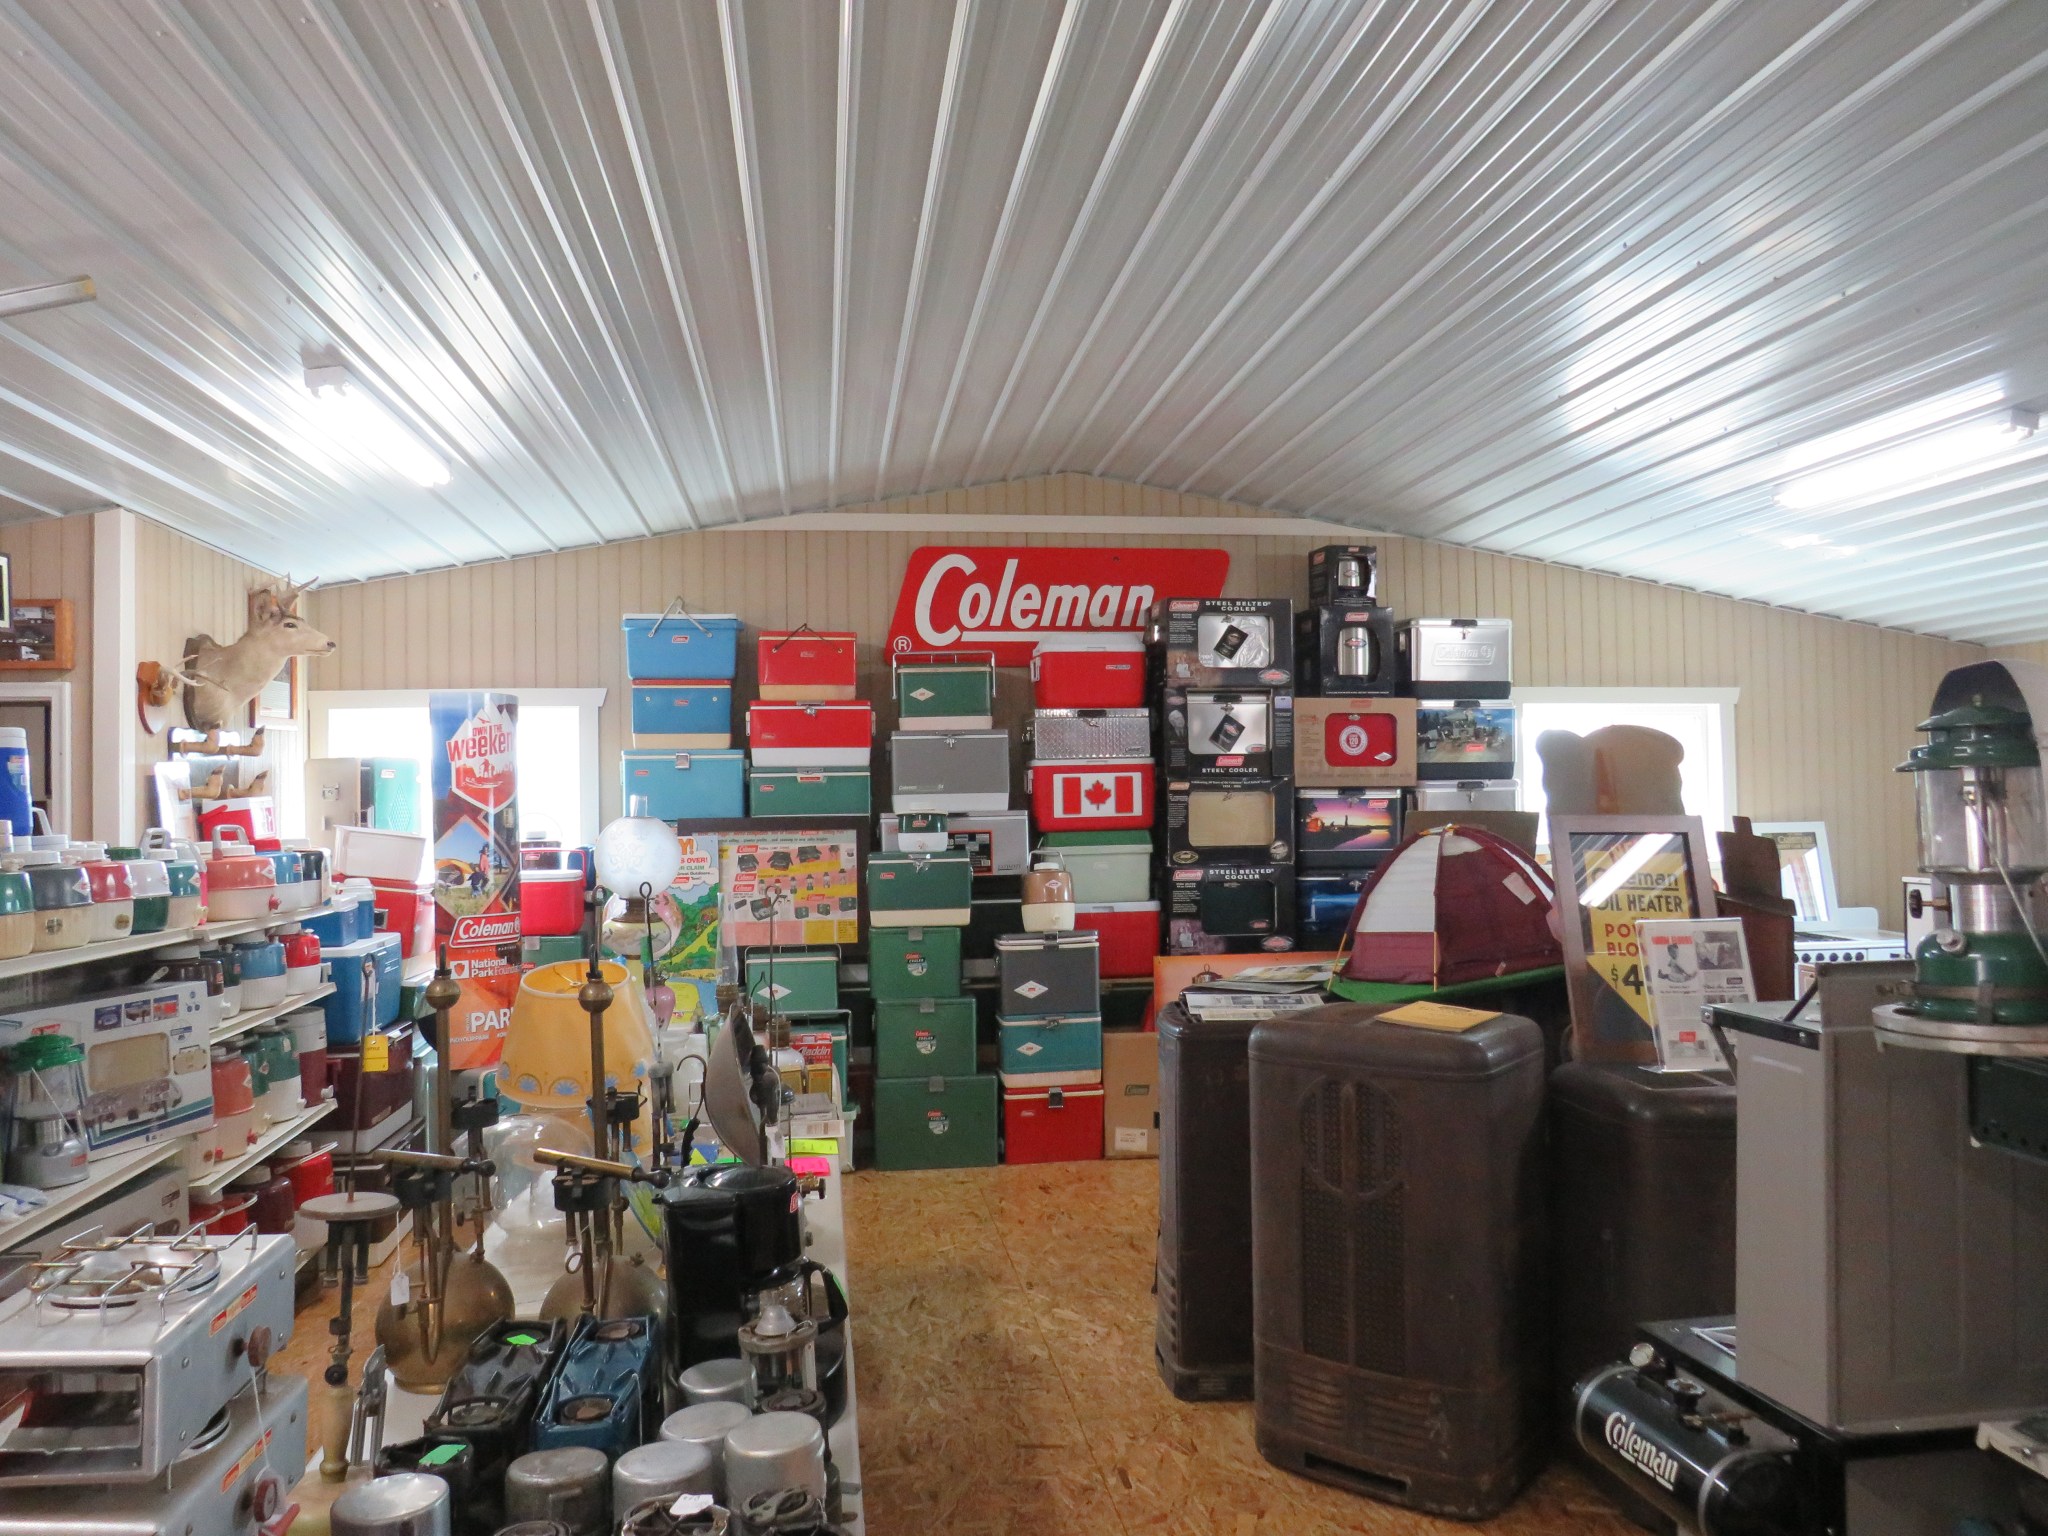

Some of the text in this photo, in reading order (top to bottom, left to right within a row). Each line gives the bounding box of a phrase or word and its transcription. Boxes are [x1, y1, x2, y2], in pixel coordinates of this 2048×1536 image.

[915, 553, 1154, 646] Coleman
[472, 724, 503, 737] OWN THE
[447, 725, 513, 763] weeken
[1175, 871, 1201, 879] Coleman
[1627, 894, 1683, 912] HEATER
[459, 919, 513, 940] Coleman
[471, 956, 507, 969] National
[471, 968, 494, 978] Park
[470, 1008, 514, 1032] PAR
[801, 1046, 831, 1056] Aladdin
[1605, 1411, 1678, 1484] Coleman
